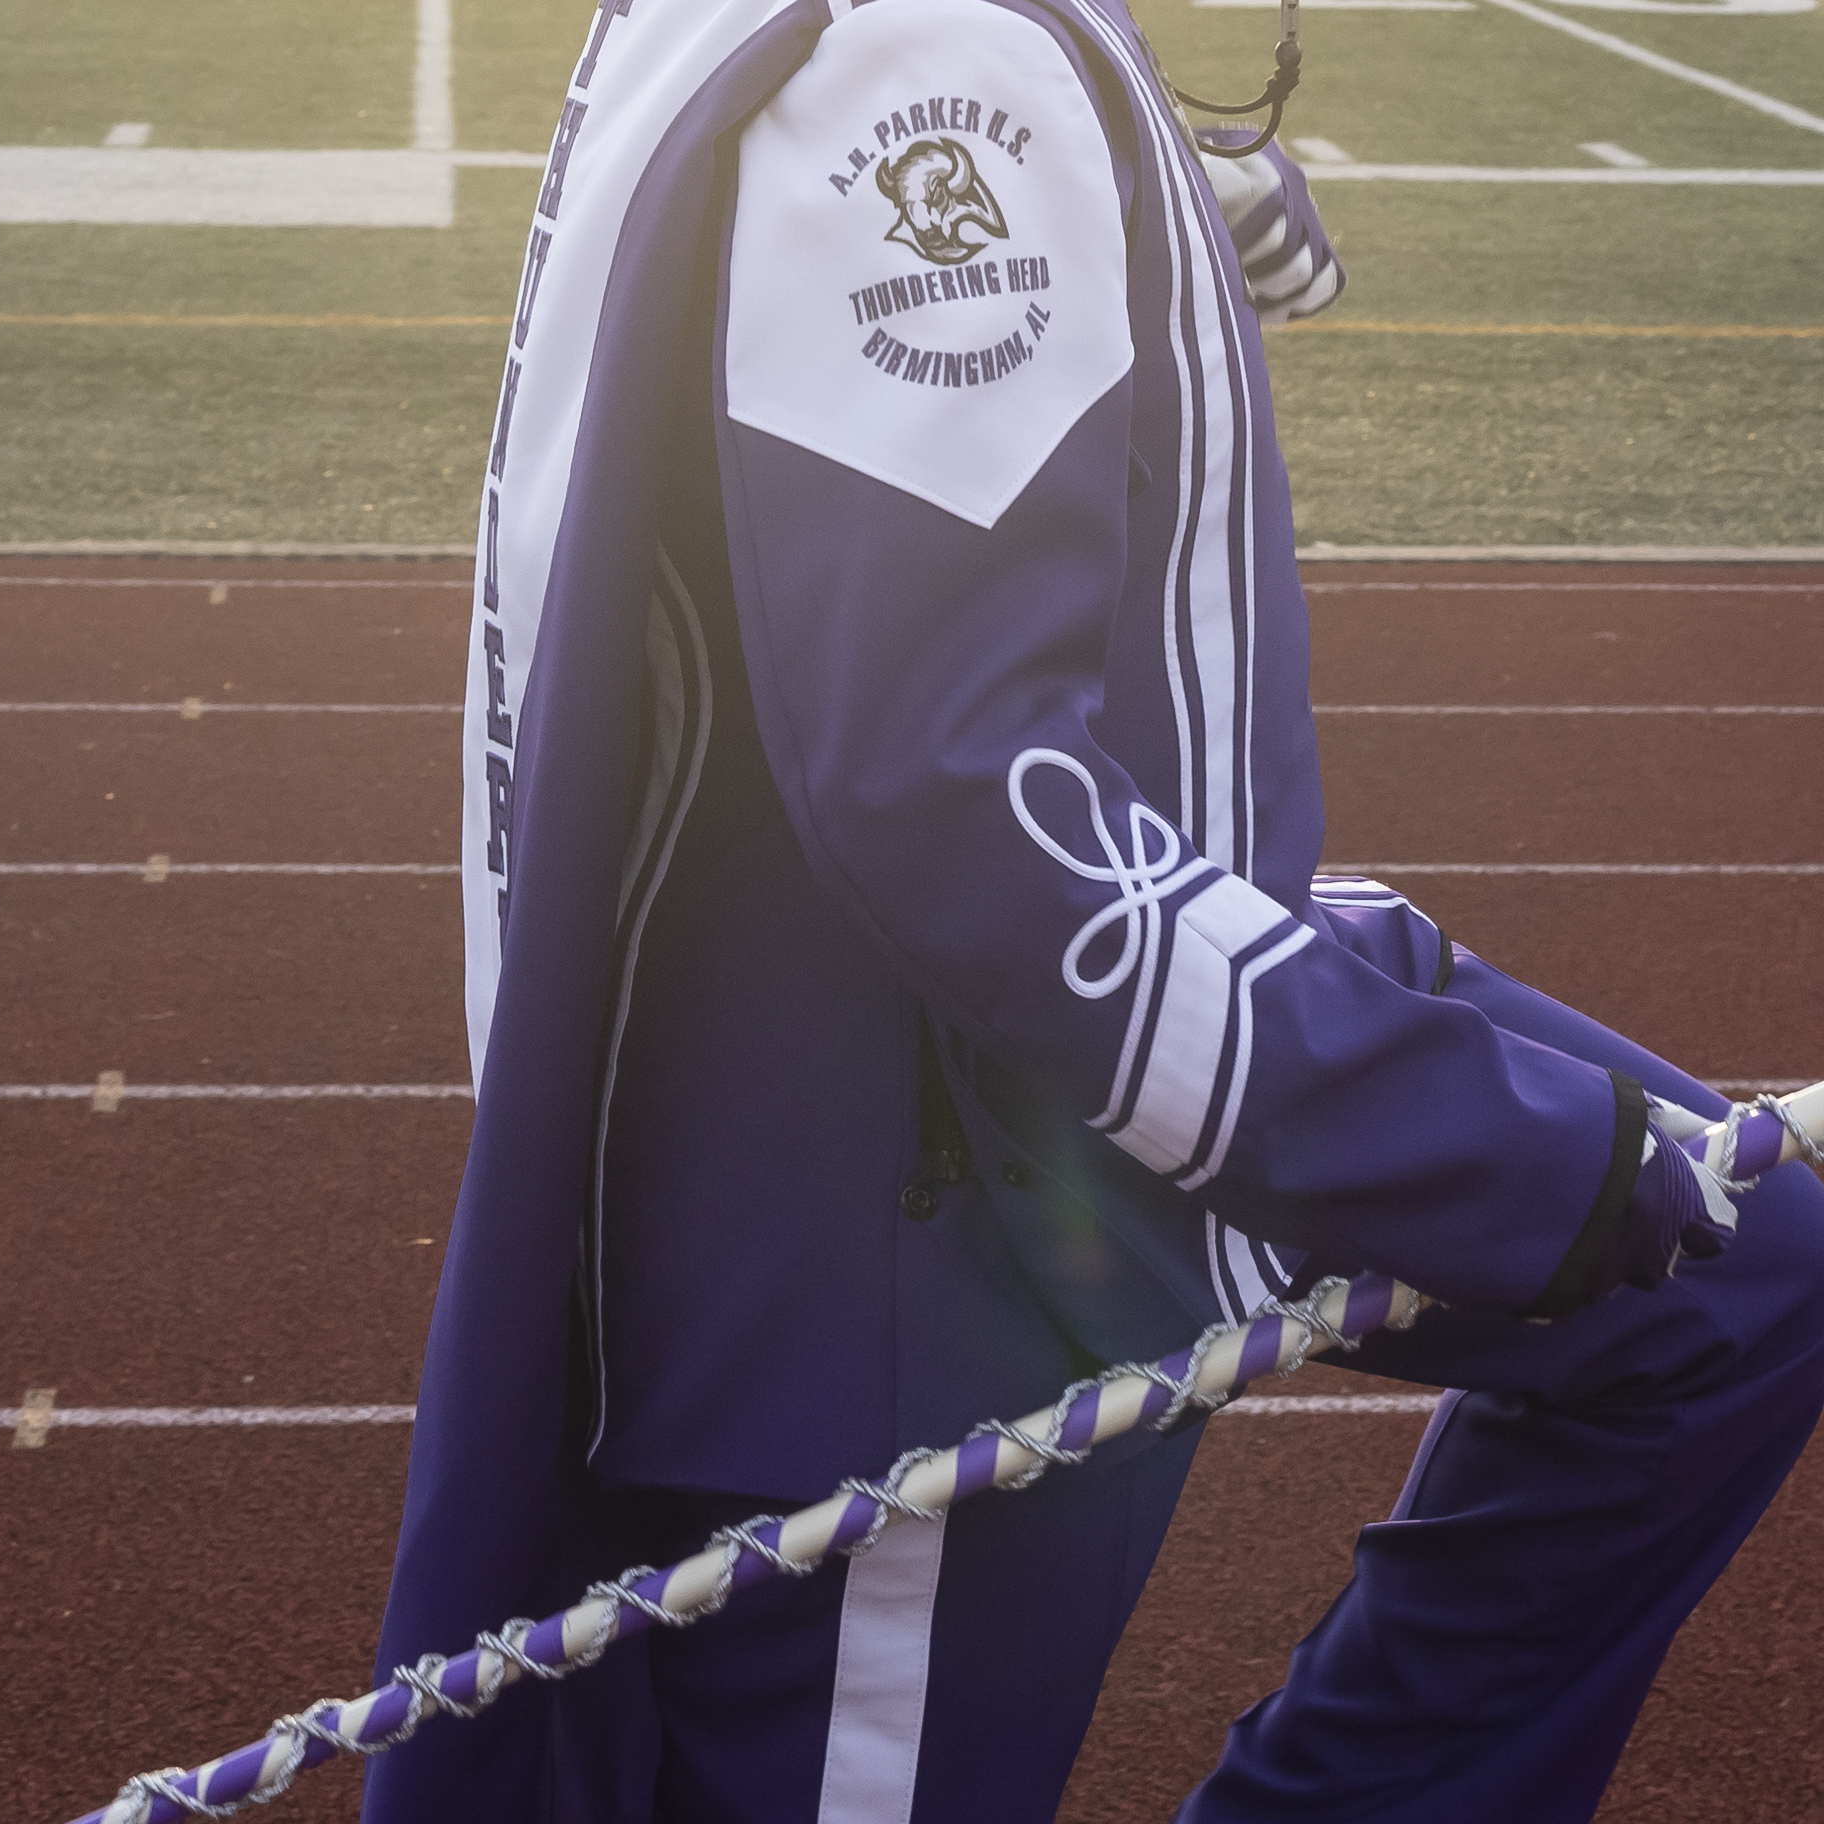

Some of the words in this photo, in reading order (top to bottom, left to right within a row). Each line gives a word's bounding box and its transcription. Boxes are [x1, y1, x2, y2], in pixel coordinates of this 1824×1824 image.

[828, 147, 877, 198] A.H.
[873, 96, 982, 151] PARKER
[986, 108, 1032, 166] H.S.
[848, 260, 1002, 326] THUNDERING
[1006, 256, 1051, 293] HERD
[861, 326, 1034, 388] BIRMINGHAM,
[1025, 300, 1051, 342] AL
